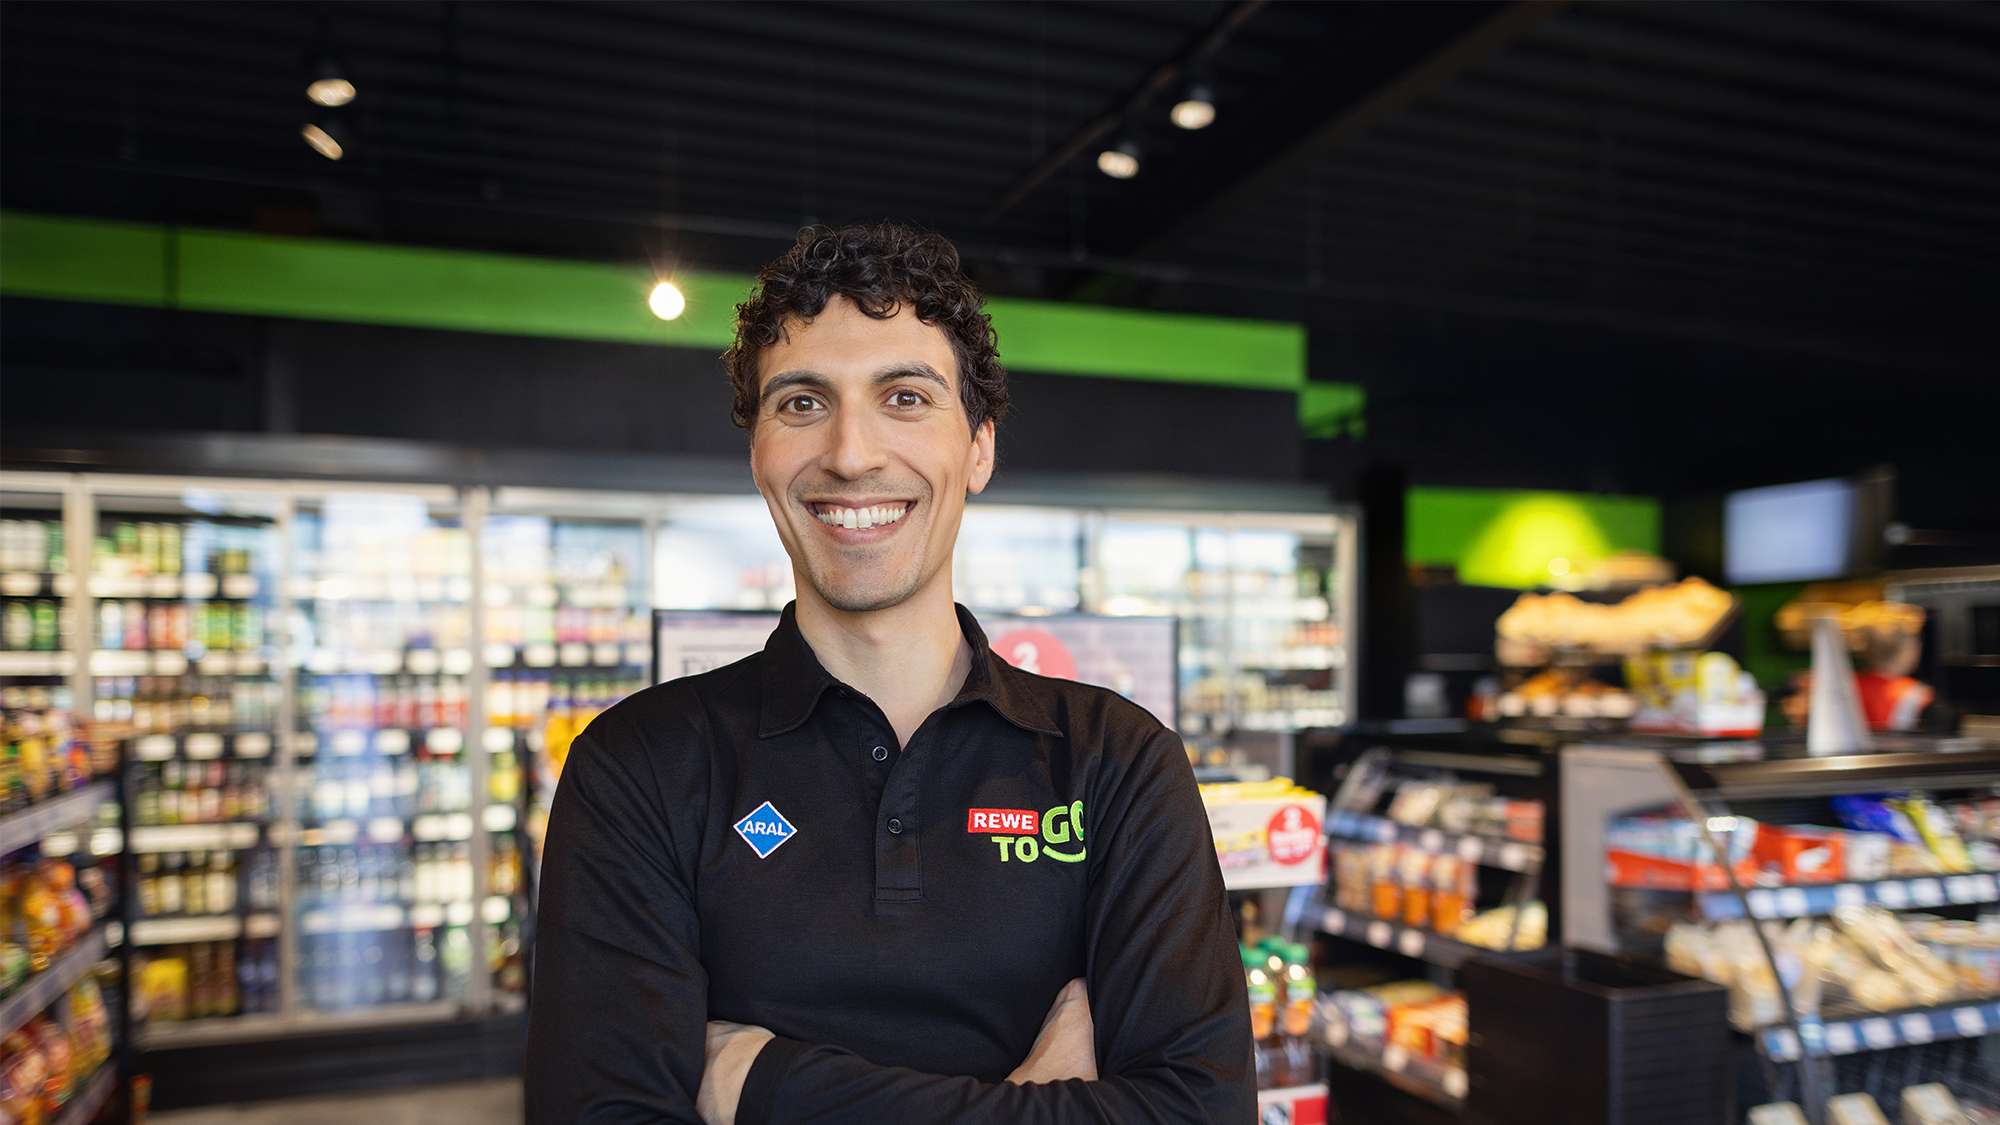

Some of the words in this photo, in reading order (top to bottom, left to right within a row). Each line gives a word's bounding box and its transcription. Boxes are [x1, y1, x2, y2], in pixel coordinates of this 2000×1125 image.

[742, 820, 788, 836] ARAL
[973, 812, 1034, 830] REWE
[991, 836, 1039, 863] TO
